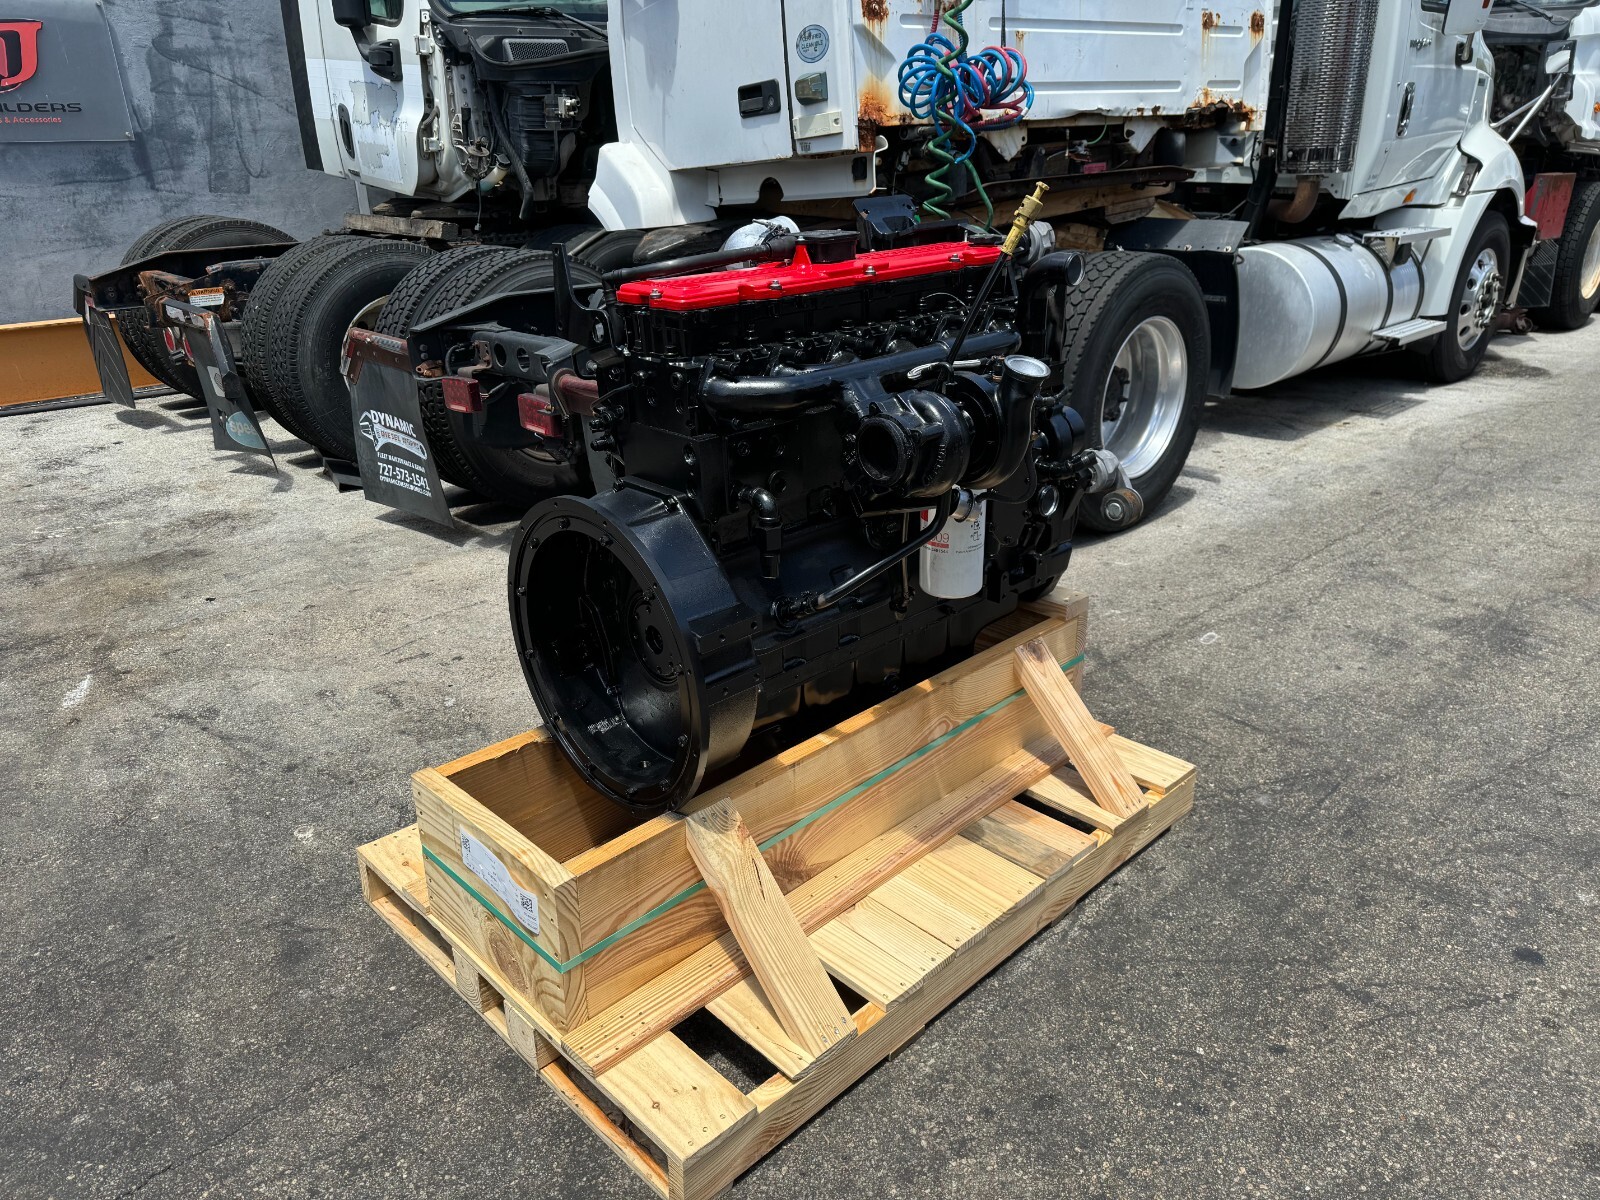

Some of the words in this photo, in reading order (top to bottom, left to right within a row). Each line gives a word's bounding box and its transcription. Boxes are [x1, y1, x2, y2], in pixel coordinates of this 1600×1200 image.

[370, 409, 417, 438] DYNAMIC
[381, 431, 400, 441] DIESEL
[377, 462, 431, 490] 727-573-1541
[932, 533, 950, 543] 09
